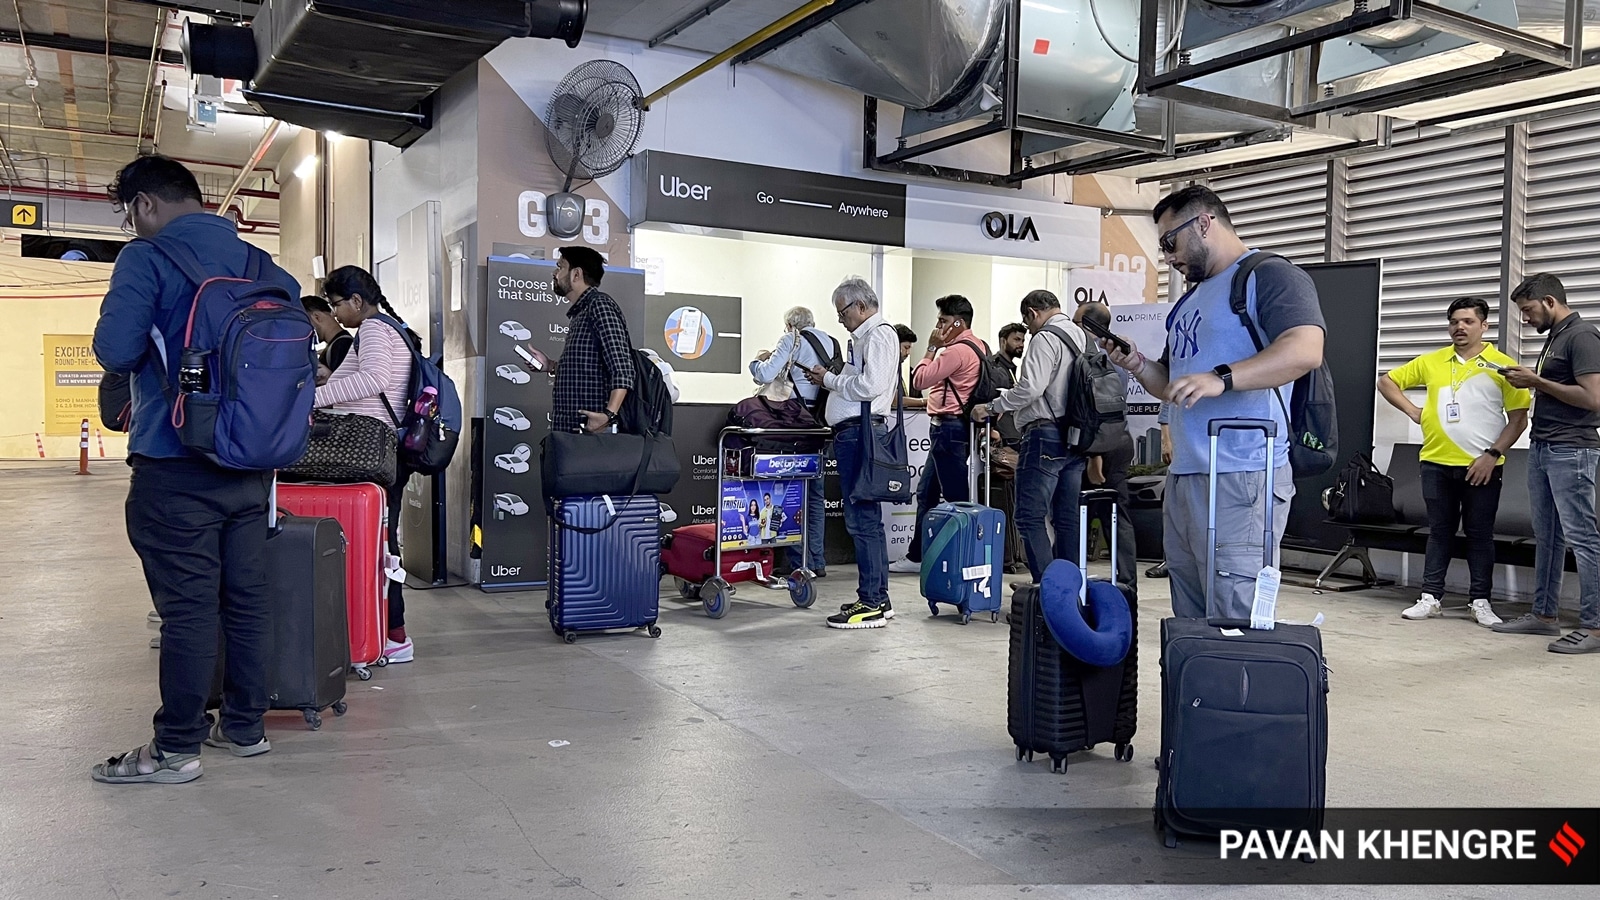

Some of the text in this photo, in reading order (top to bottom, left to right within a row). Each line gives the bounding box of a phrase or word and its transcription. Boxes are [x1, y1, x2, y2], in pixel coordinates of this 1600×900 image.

[659, 175, 712, 201] Uber
[756, 191, 889, 218] Go Anywhere
[518, 190, 610, 245] G3
[980, 211, 1040, 242] OLA
[498, 276, 548, 290] Choose
[498, 288, 571, 306] that suits yo
[1074, 287, 1109, 306] OLA
[1116, 313, 1162, 322] OLA PRIME
[548, 323, 570, 334] Ube
[55, 346, 94, 357] EXCITEM
[909, 438, 931, 452] ee
[692, 455, 717, 465] Uber
[691, 505, 716, 515] Uber
[823, 499, 840, 509] ber
[891, 524, 907, 533] Our
[491, 565, 522, 577] Uber
